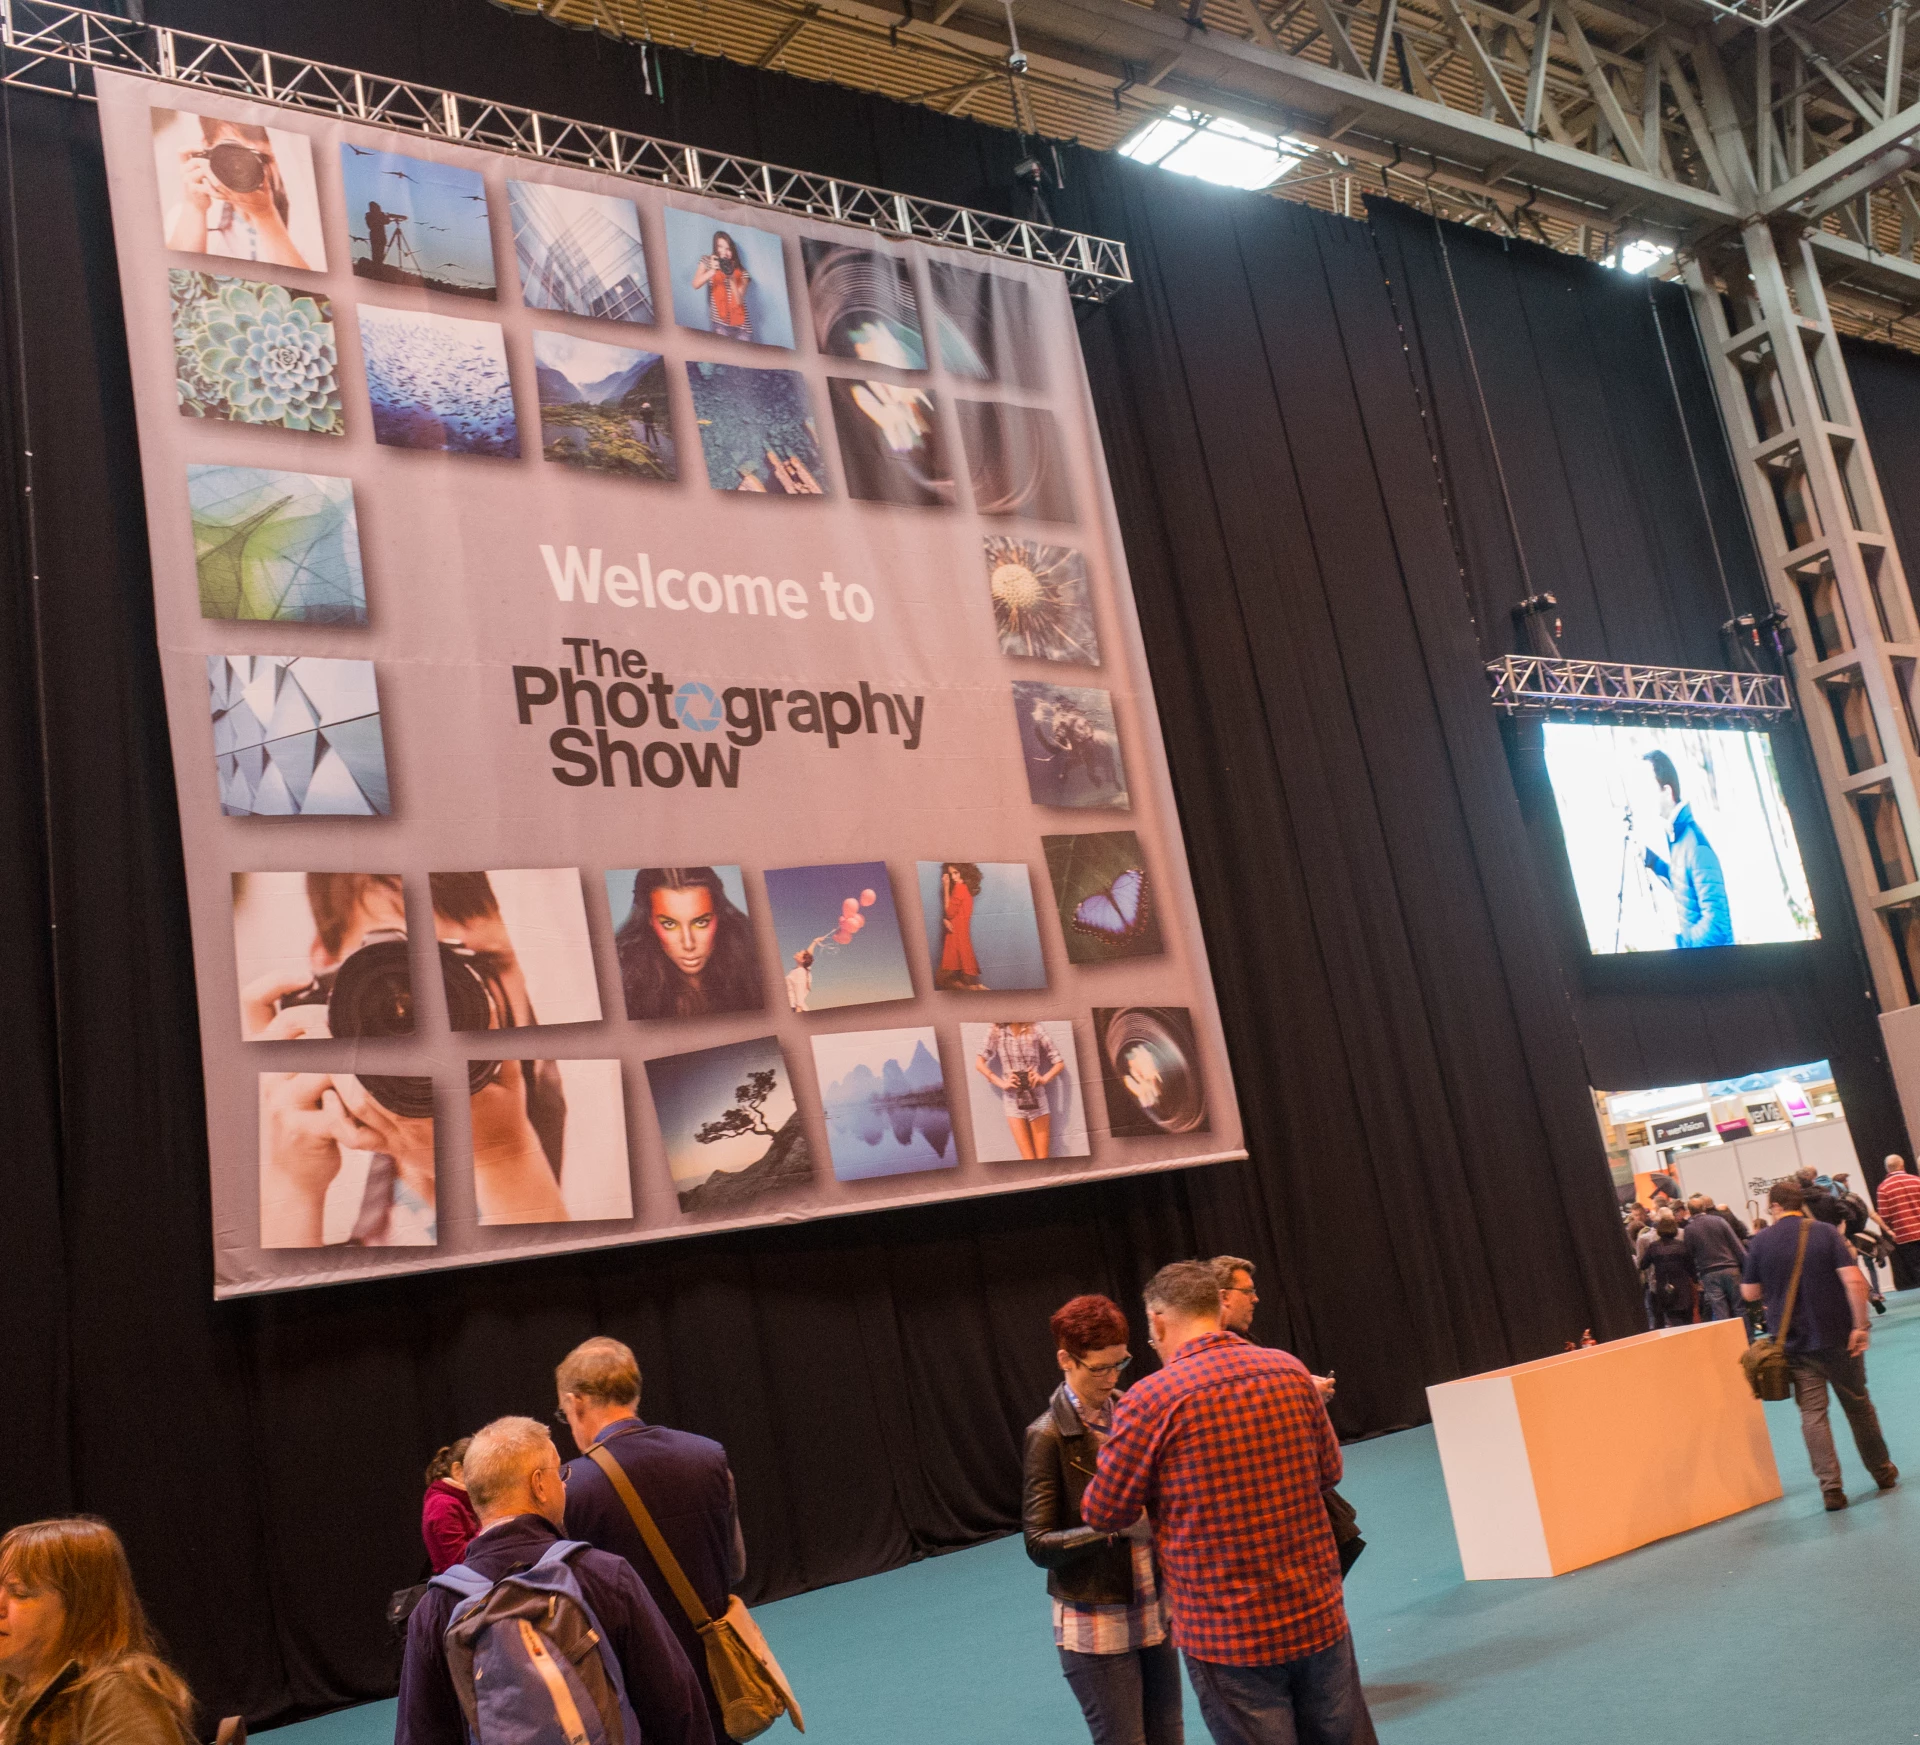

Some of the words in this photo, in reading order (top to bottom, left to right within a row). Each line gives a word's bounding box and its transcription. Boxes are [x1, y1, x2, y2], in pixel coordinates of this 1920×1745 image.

[539, 544, 809, 620] Welcome
[819, 571, 875, 623] to
[562, 637, 648, 679] The
[512, 665, 925, 749] Photography
[549, 727, 740, 789] Show
